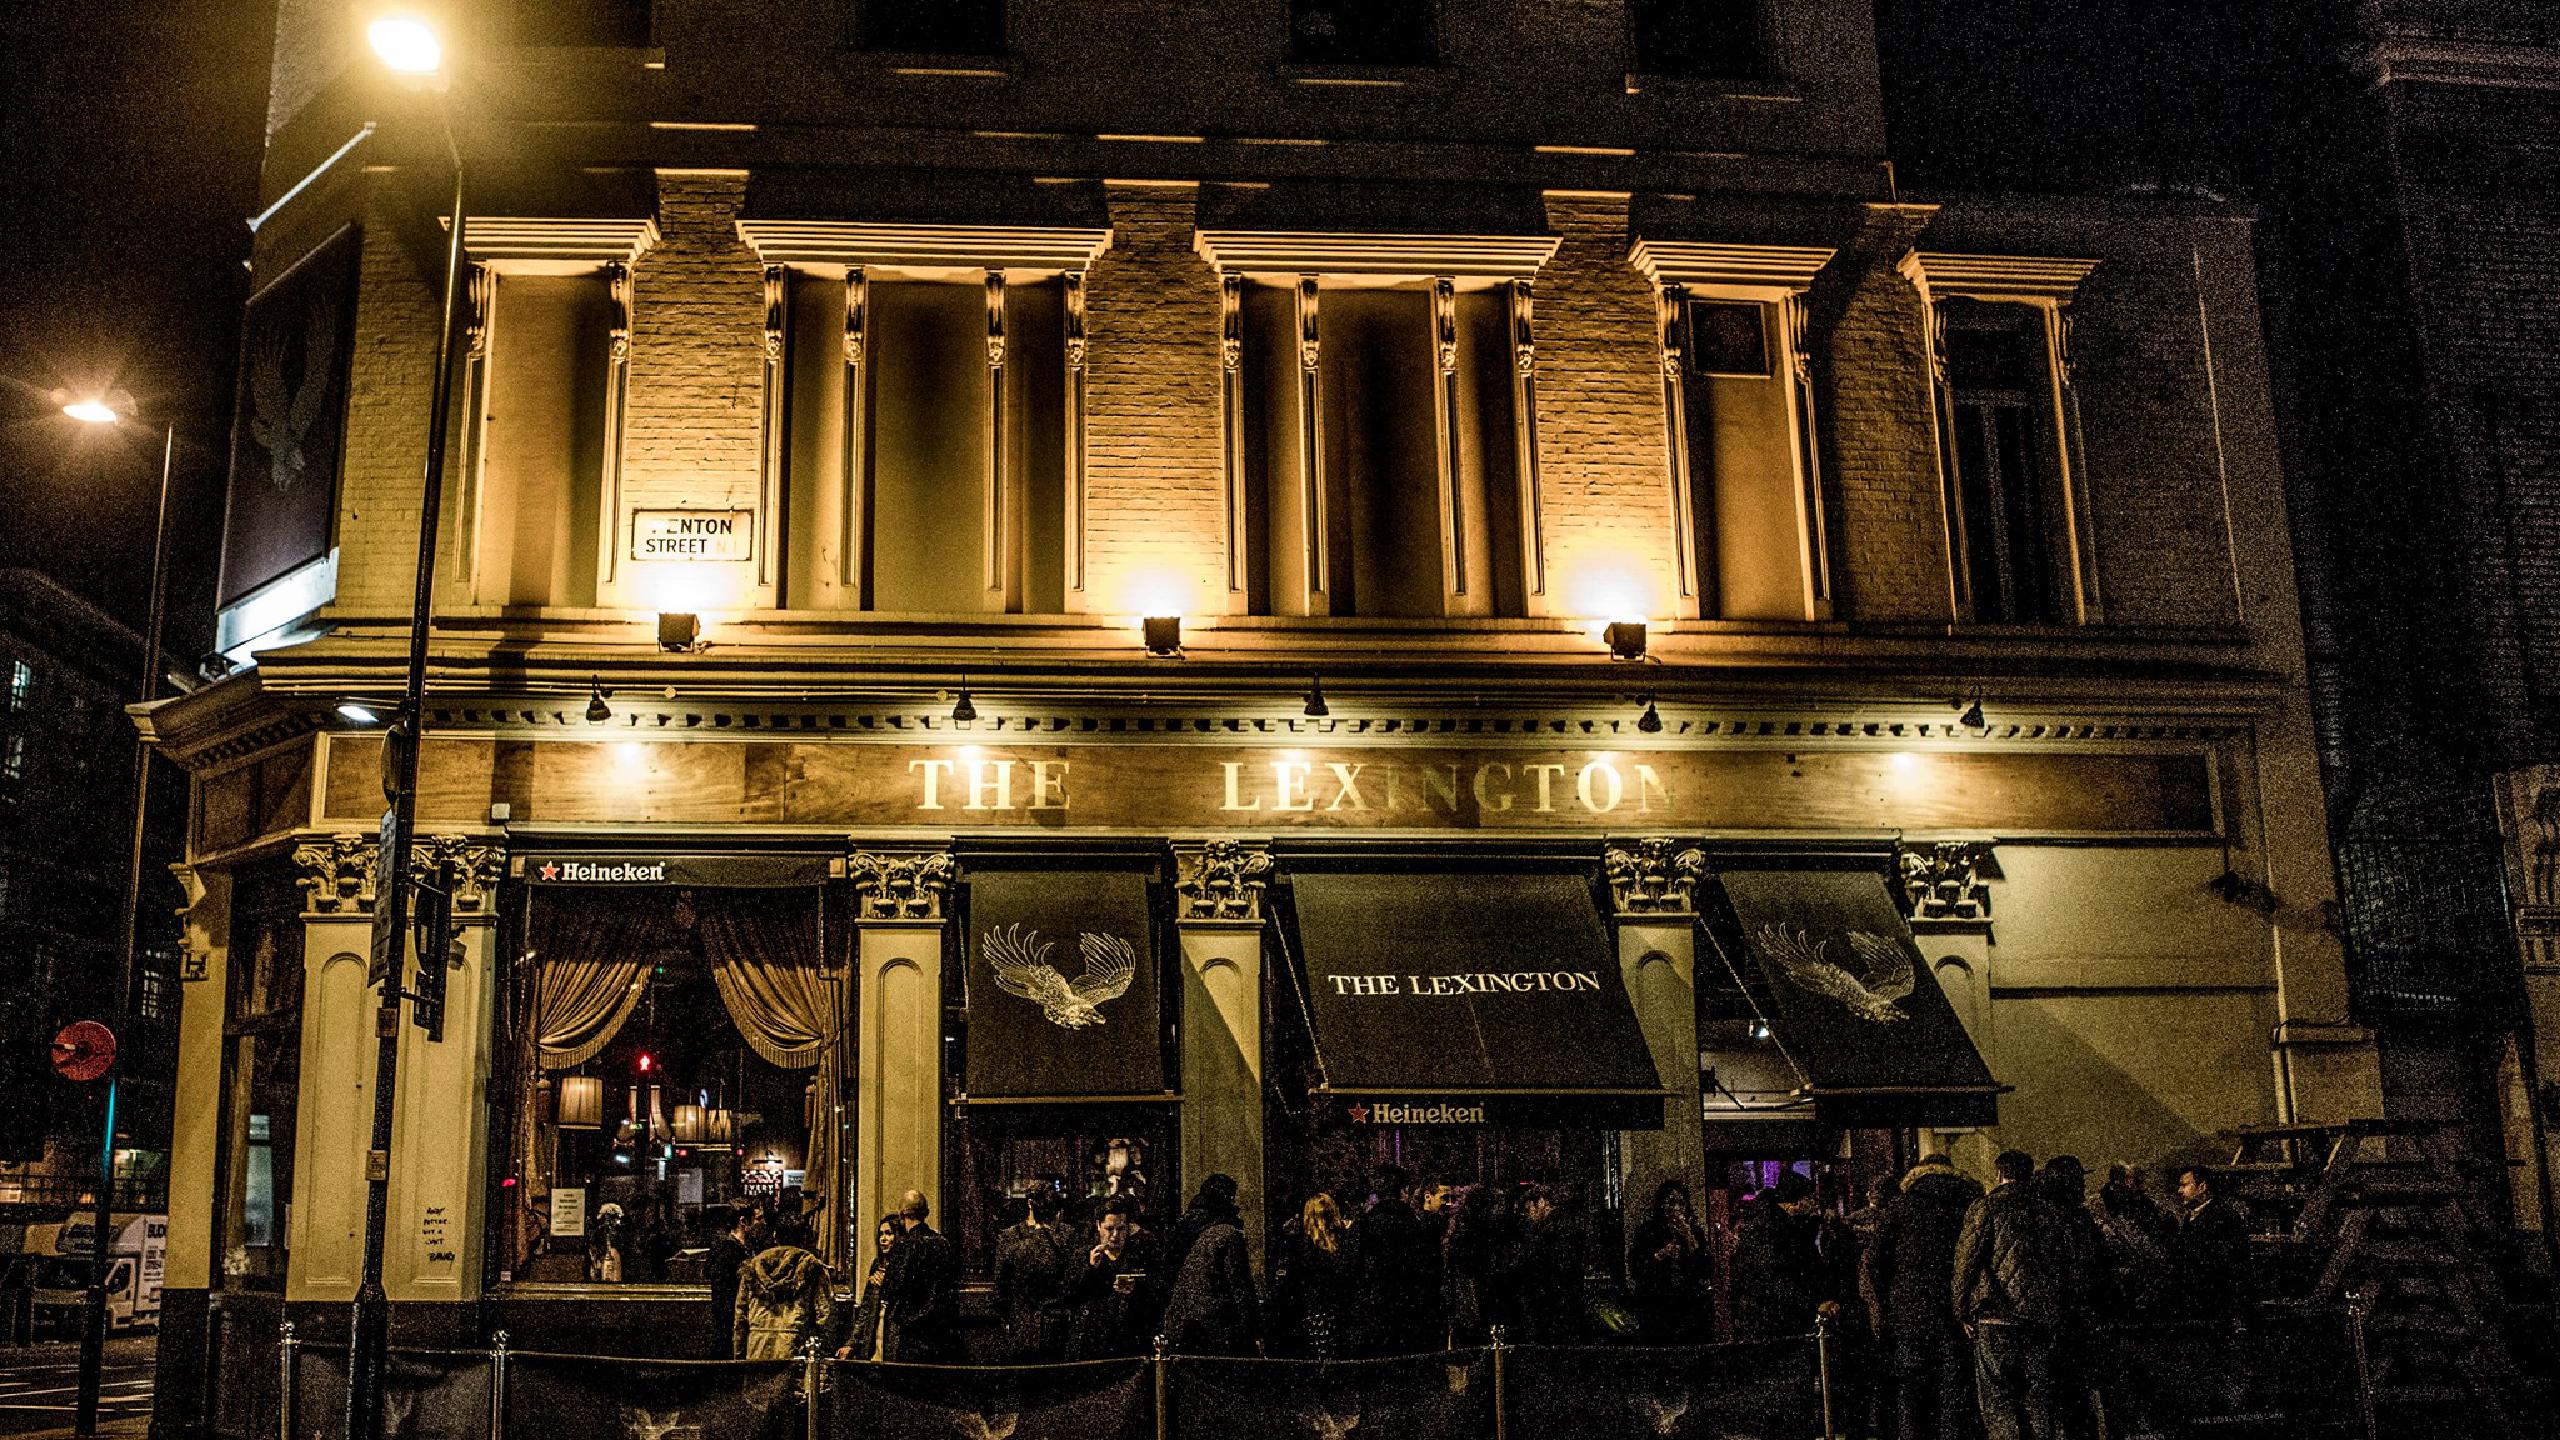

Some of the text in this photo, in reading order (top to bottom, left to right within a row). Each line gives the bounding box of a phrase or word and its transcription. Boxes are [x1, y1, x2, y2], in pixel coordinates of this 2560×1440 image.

[650, 518, 733, 535] ENTON
[645, 538, 708, 553] STREET
[908, 759, 1677, 812] THE LEXINGTON
[561, 862, 665, 881] Heineken
[1328, 970, 1601, 995] THE LEXINGTON
[1372, 1102, 1485, 1124] Heineken
